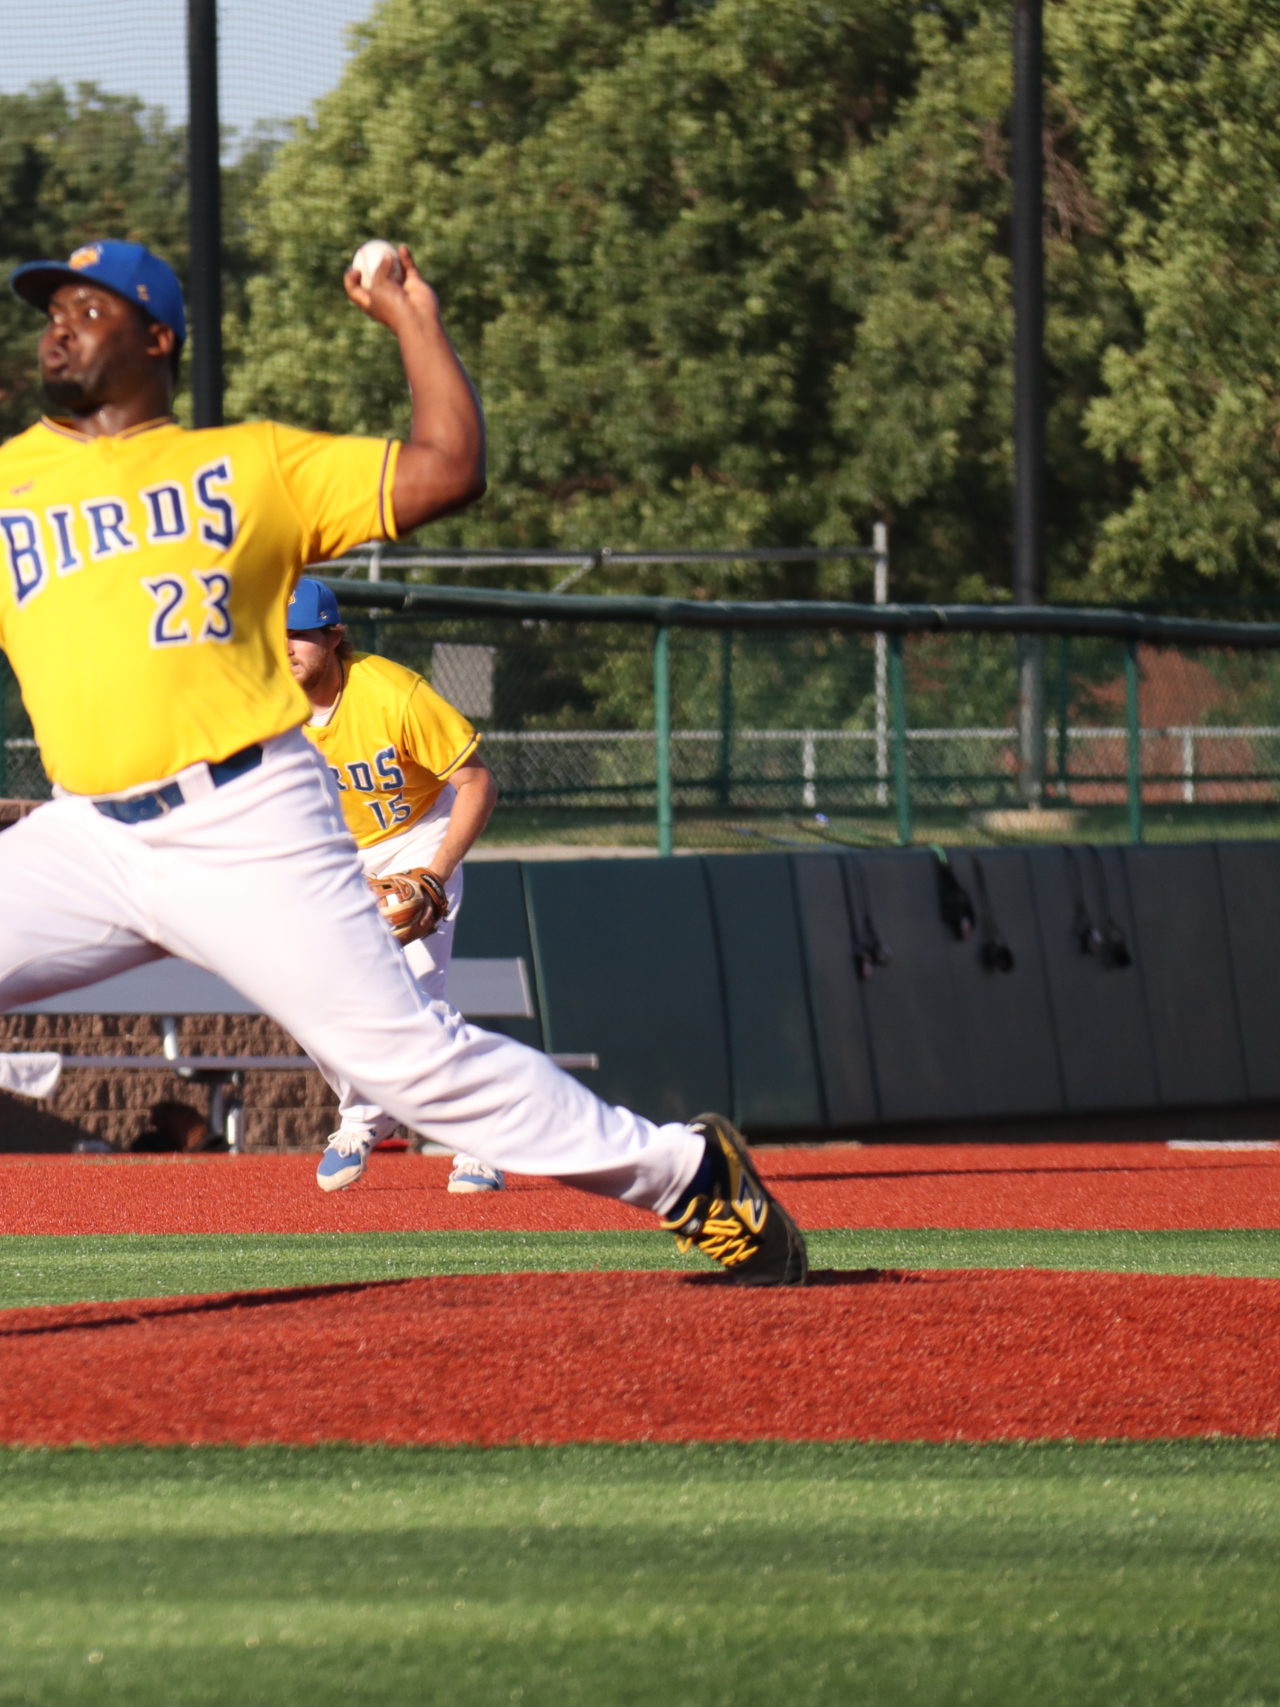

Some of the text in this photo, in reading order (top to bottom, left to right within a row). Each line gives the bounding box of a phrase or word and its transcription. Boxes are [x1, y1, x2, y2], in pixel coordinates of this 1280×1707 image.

[142, 568, 232, 647] 23
[327, 746, 405, 792] RDS
[364, 791, 412, 830] 15
